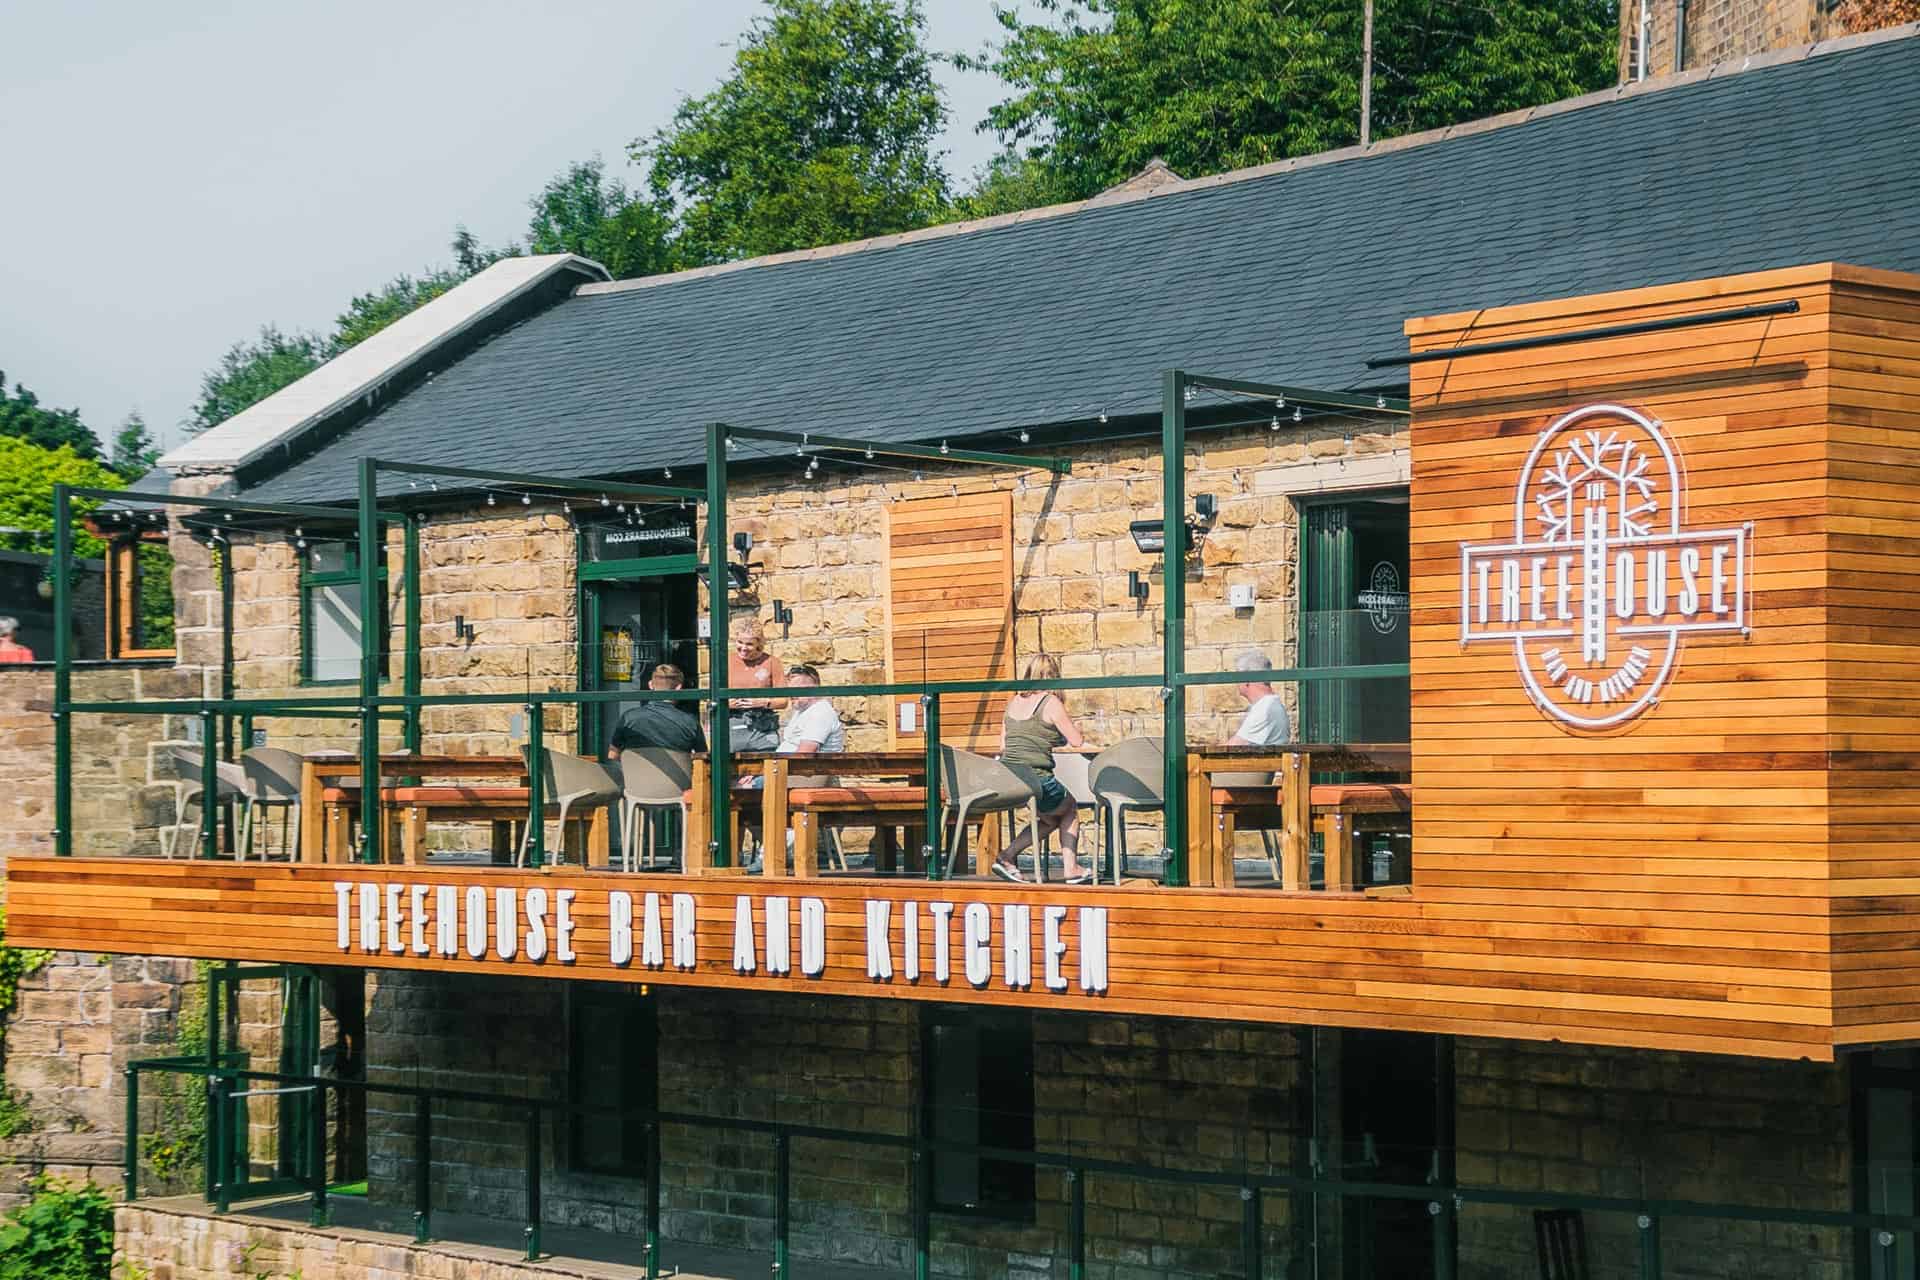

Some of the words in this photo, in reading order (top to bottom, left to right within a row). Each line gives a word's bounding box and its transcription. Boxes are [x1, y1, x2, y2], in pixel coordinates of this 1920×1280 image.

[334, 881, 576, 963] TREEHOUSE
[609, 890, 697, 969] BAR
[733, 895, 826, 975] AND
[865, 901, 1108, 992] KITCHEN
